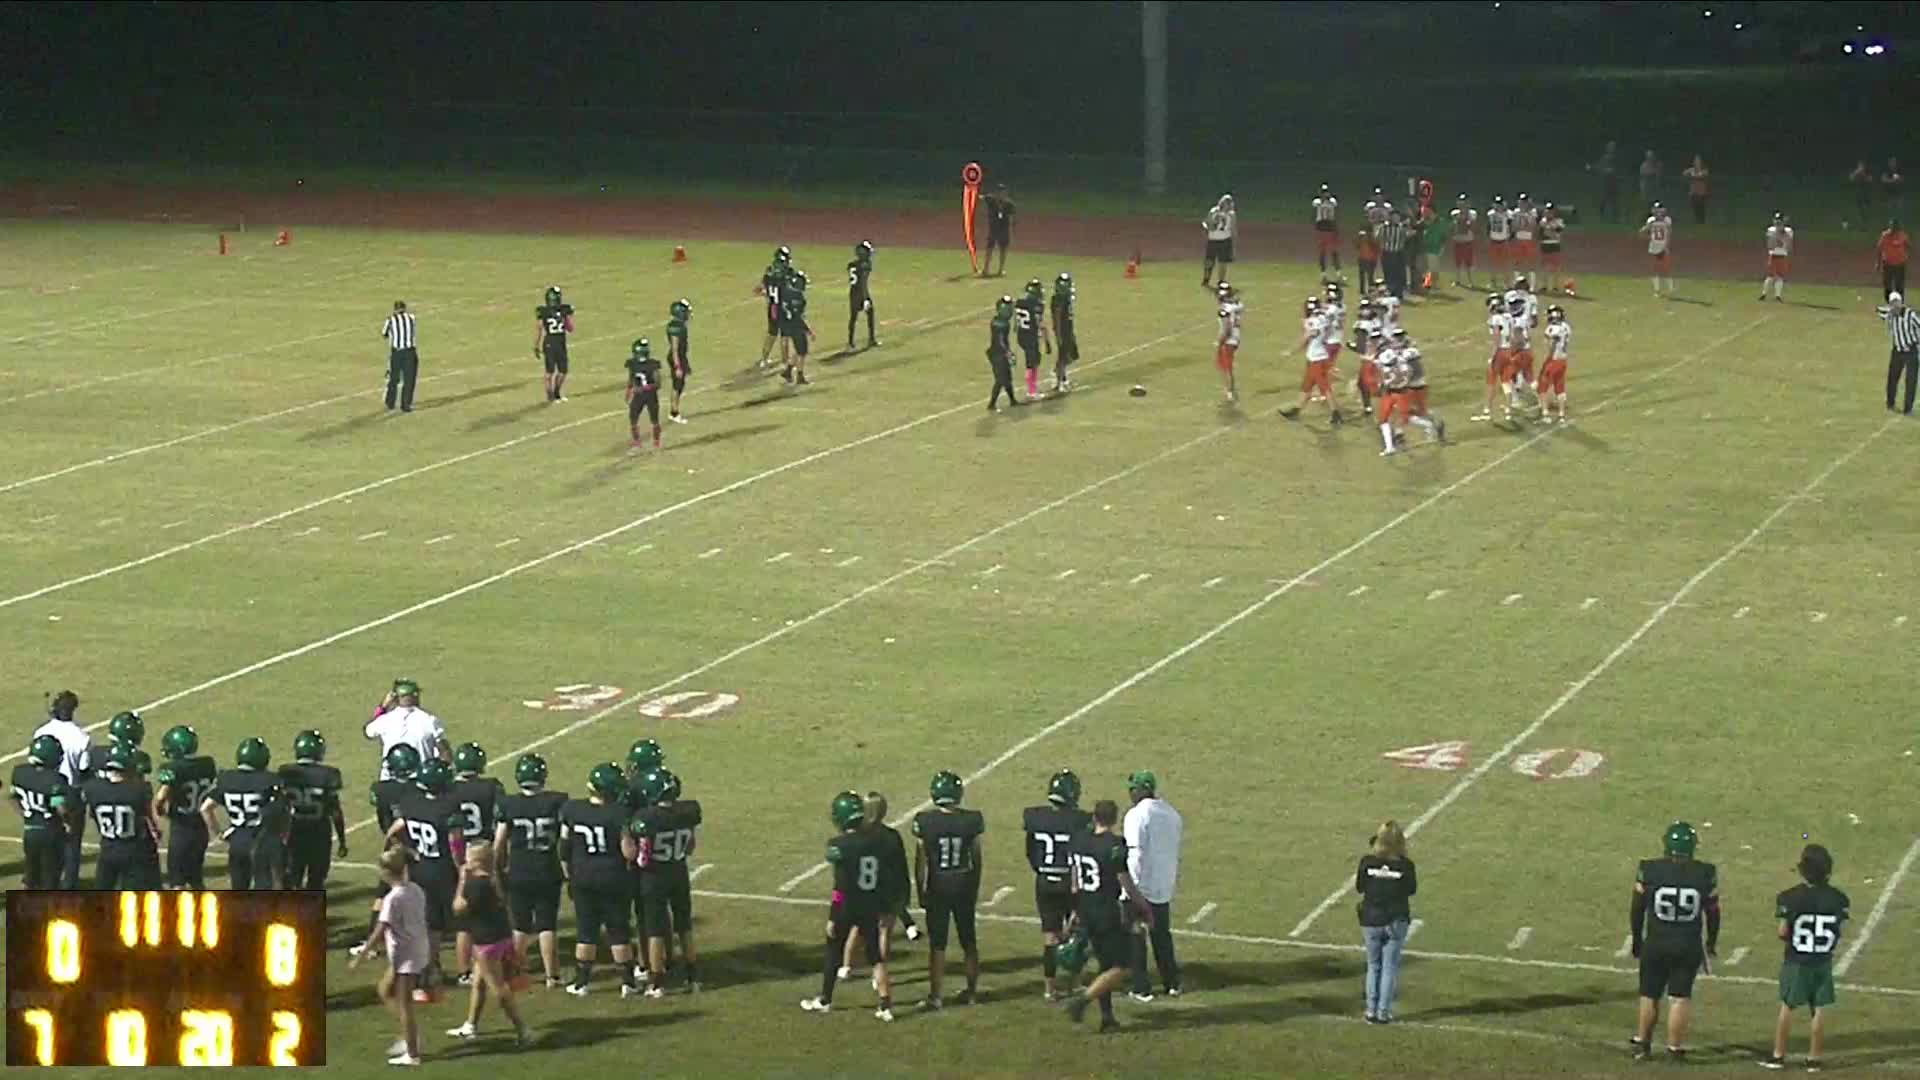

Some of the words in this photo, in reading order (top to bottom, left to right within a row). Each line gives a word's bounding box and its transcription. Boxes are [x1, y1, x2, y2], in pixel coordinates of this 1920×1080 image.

[95, 805, 136, 839] 60
[461, 802, 483, 836] 3
[513, 817, 557, 851] 75
[573, 824, 607, 854] 71
[653, 829, 693, 862] 50
[938, 836, 962, 868] 11
[857, 855, 879, 891] 8
[1073, 853, 1101, 892] 13
[1653, 886, 1700, 922] 69
[1792, 914, 1837, 953] 65
